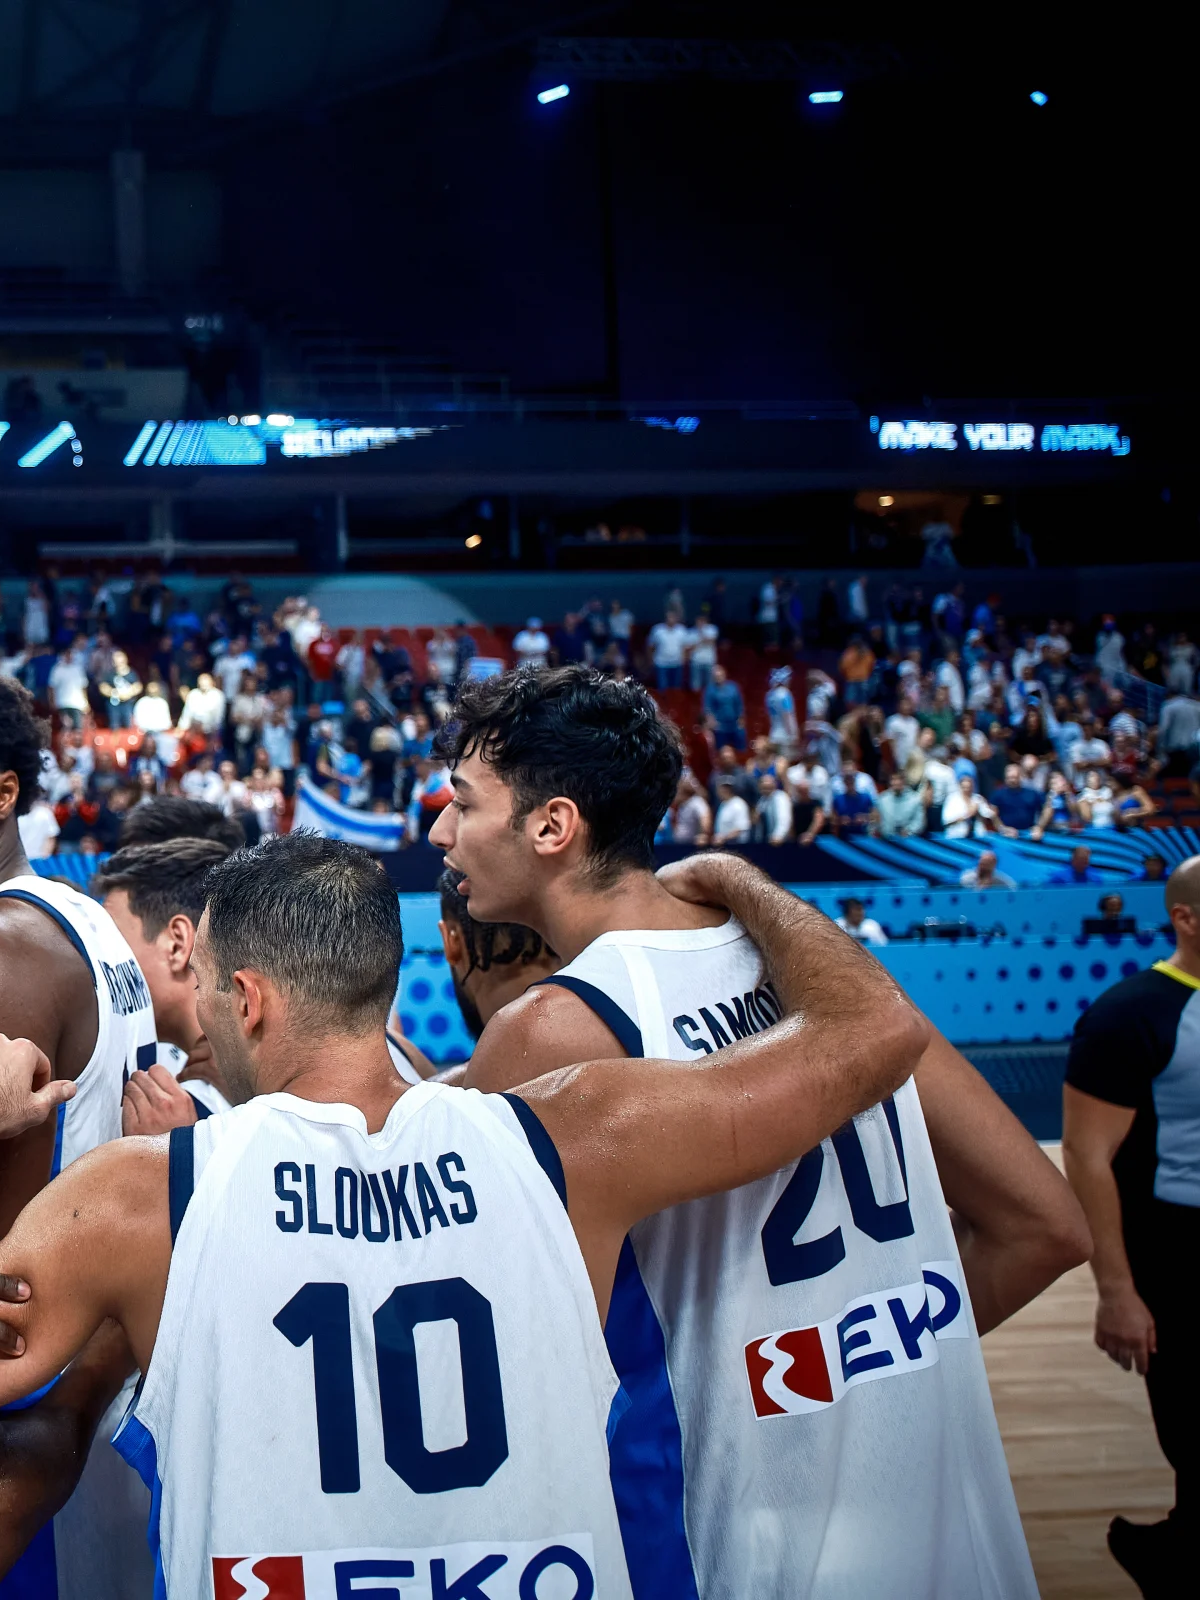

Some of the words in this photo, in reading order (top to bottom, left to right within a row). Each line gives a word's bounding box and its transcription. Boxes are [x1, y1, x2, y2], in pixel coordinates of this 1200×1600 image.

[879, 421, 957, 450] MAKE
[964, 422, 1035, 451] YOUR
[274, 1151, 478, 1243] SLOUKAS
[761, 1094, 915, 1287] 20
[272, 1276, 509, 1494] 10
